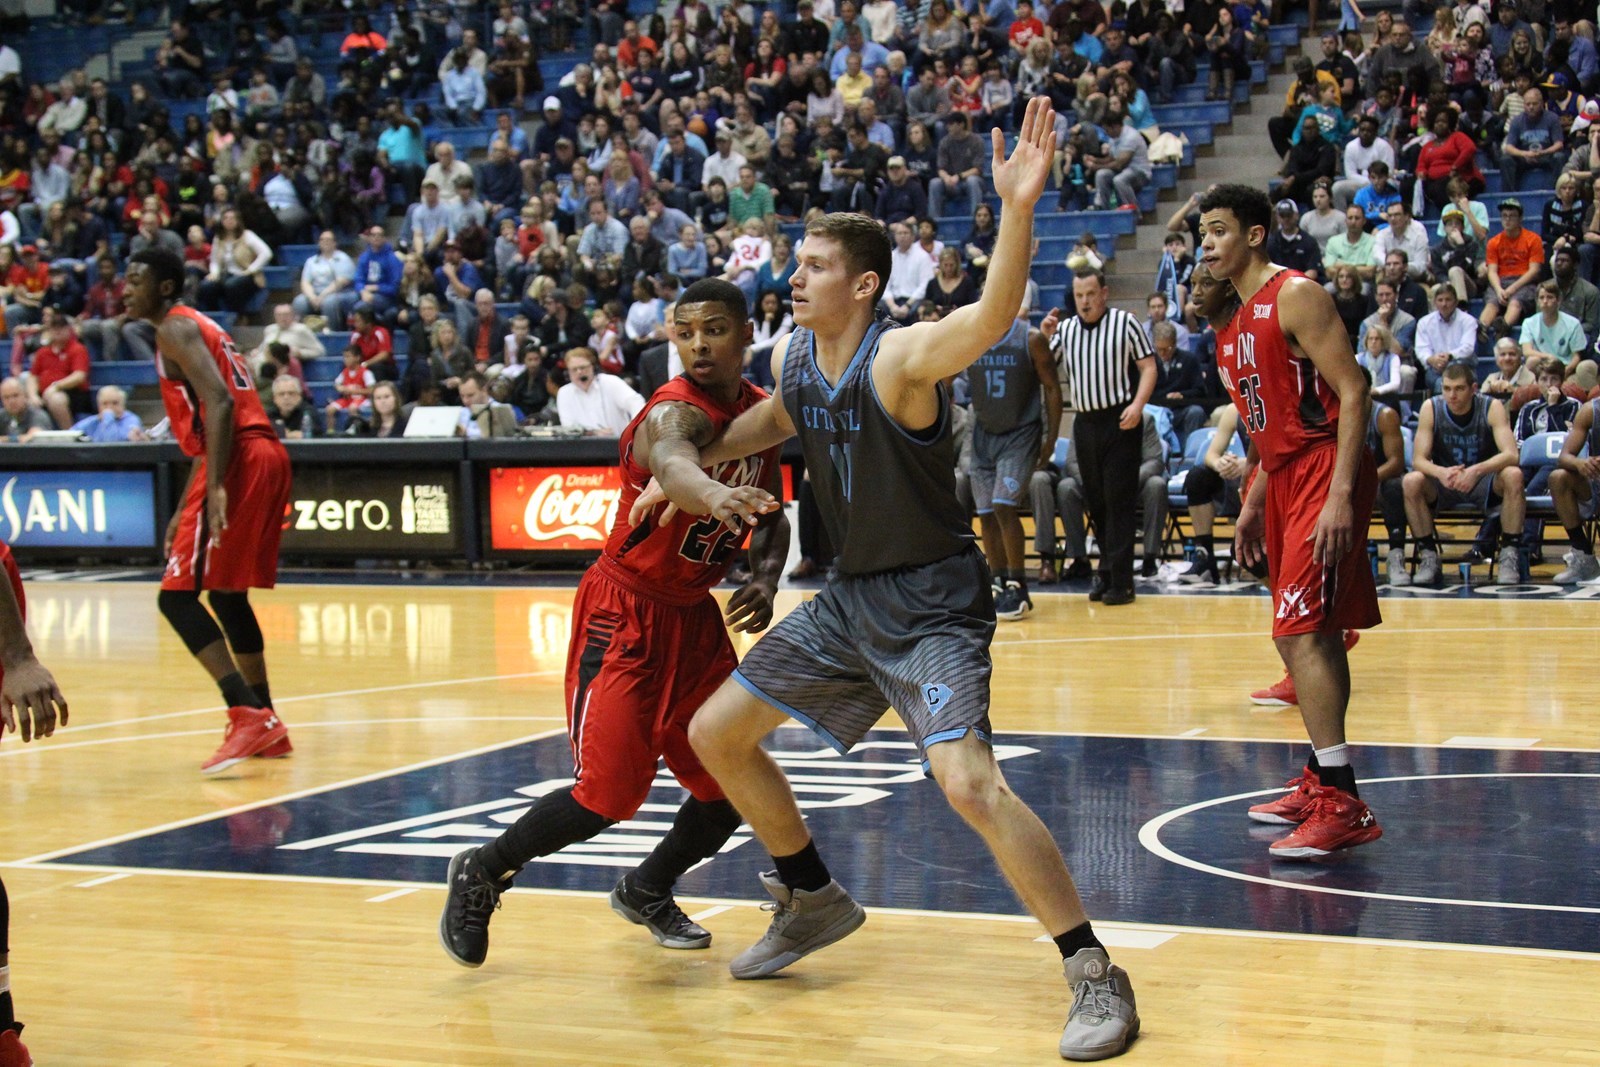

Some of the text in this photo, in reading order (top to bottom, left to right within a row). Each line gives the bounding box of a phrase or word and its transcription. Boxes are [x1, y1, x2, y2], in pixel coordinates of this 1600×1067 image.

[973, 355, 1016, 367] ITADEL
[985, 370, 1006, 398] 15
[1239, 374, 1267, 433] 35
[0, 476, 106, 544] SANI
